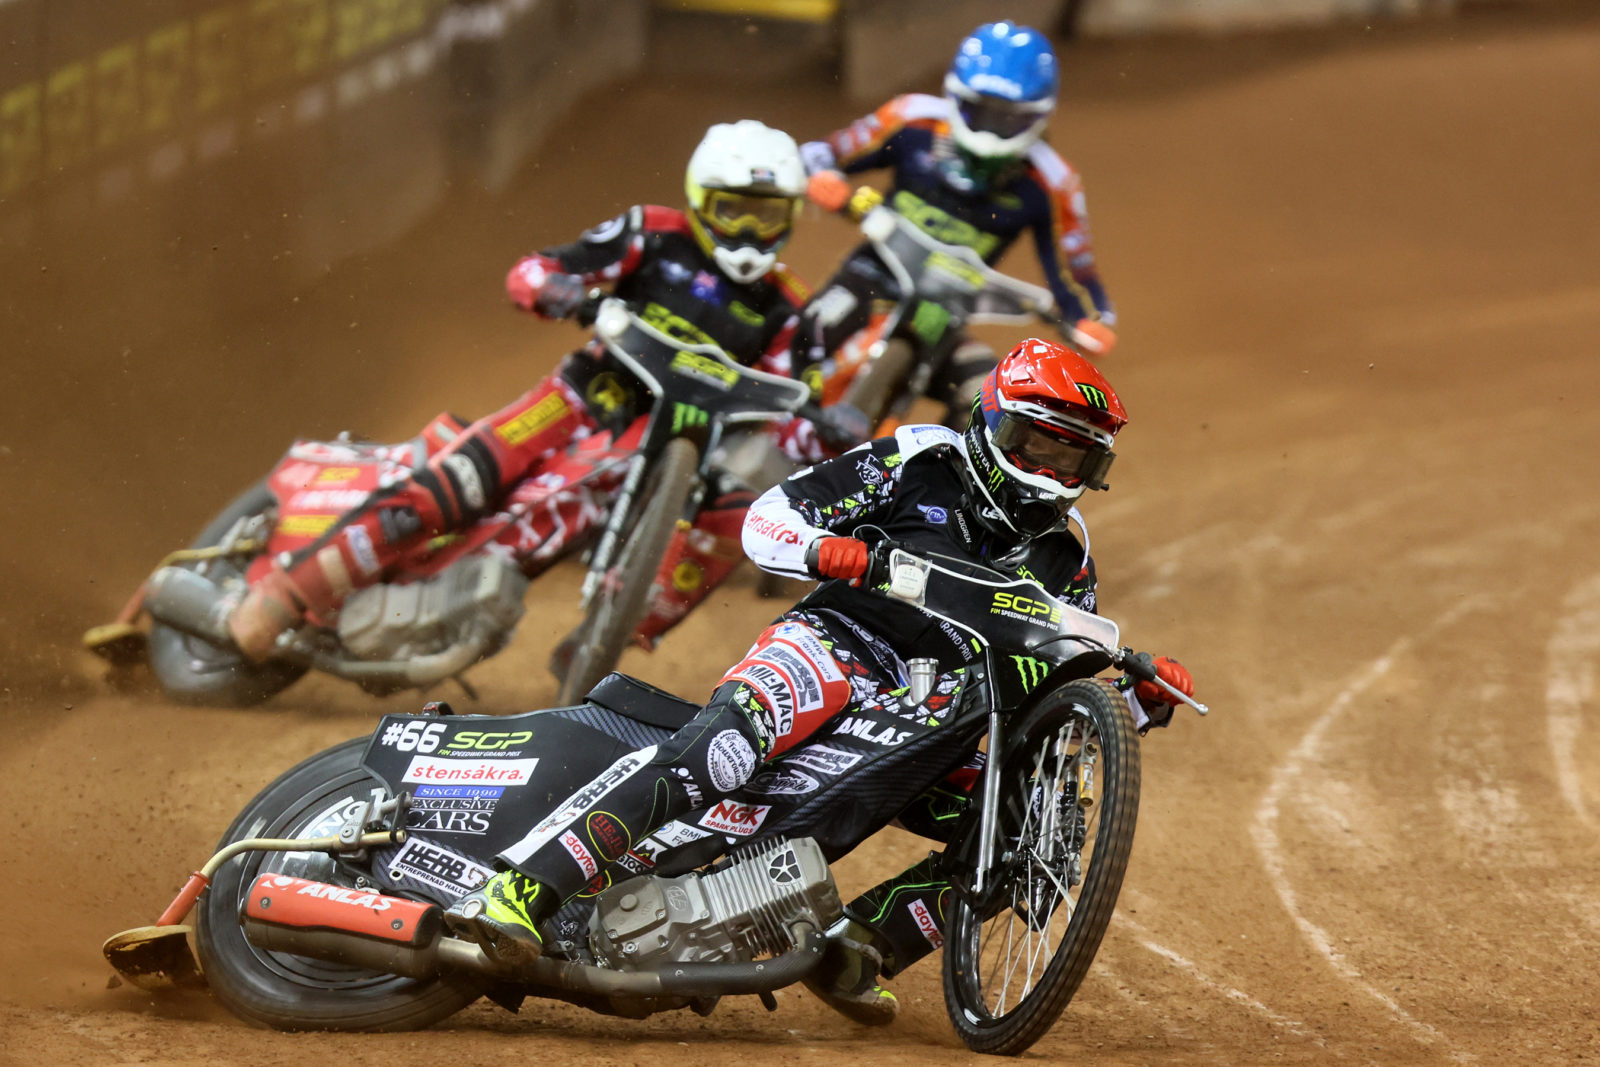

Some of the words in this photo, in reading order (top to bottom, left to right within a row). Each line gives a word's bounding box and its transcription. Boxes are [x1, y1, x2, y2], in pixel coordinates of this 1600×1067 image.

[992, 592, 1050, 616] SGP
[990, 607, 1001, 615] FIM
[1001, 609, 1029, 622] SPEEDWAY
[1028, 616, 1047, 628] GRAND
[1046, 621, 1059, 632] PRIX
[804, 635, 827, 656] BMW
[940, 620, 963, 646] RAND
[959, 642, 974, 662] PRIX
[381, 720, 447, 753] #66
[447, 731, 533, 750] SGP
[832, 717, 914, 746] ANLAS
[413, 800, 498, 810] EXCLUSIVE
[420, 788, 462, 797] SINCE
[466, 789, 498, 798] 1990
[407, 810, 492, 832] CARS
[710, 801, 766, 827] NGK
[705, 819, 729, 830] SPARK
[728, 824, 754, 835] PLUGS
[395, 862, 445, 887] ENTREPRENAD
[401, 843, 467, 881] HERB
[297, 884, 391, 911] ANLAS
